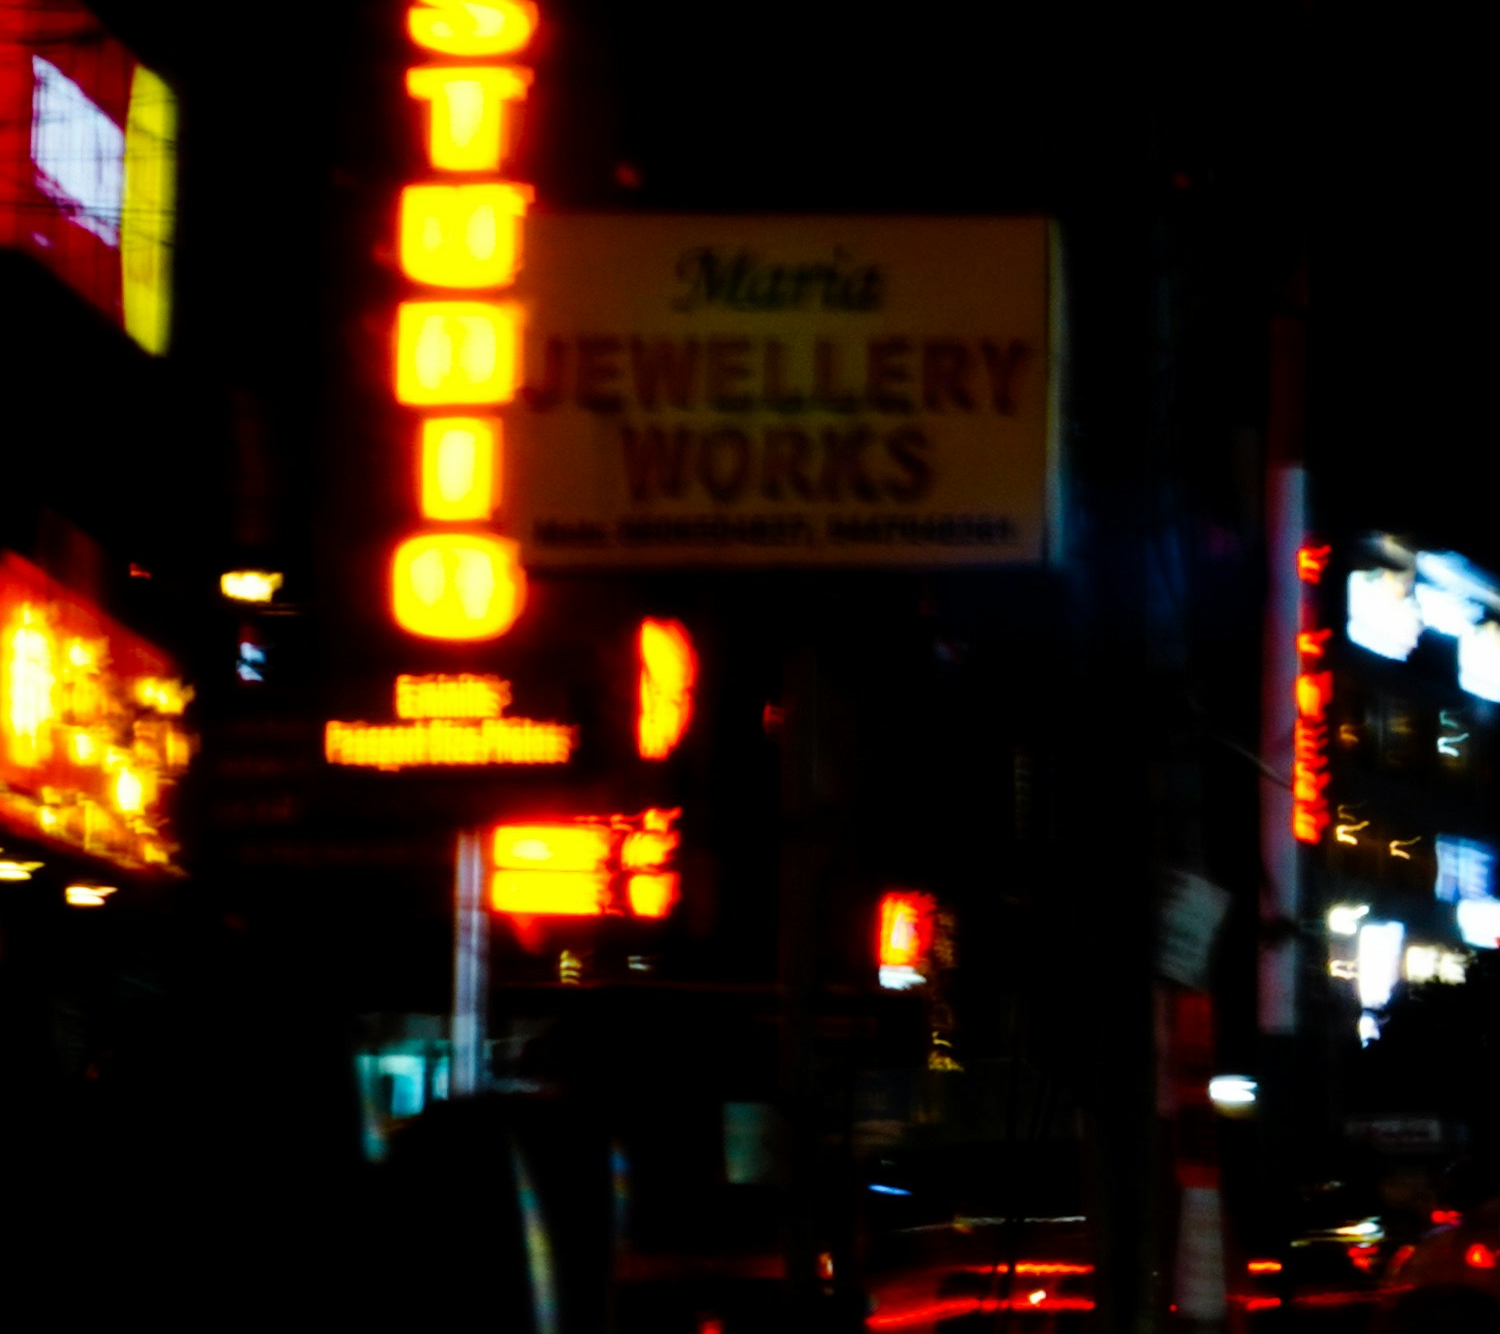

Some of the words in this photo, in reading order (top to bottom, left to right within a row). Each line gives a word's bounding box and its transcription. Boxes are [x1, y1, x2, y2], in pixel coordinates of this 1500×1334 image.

[670, 244, 885, 313] Maria
[522, 335, 1032, 416] JEWELLERY
[622, 424, 936, 503] WORKS
